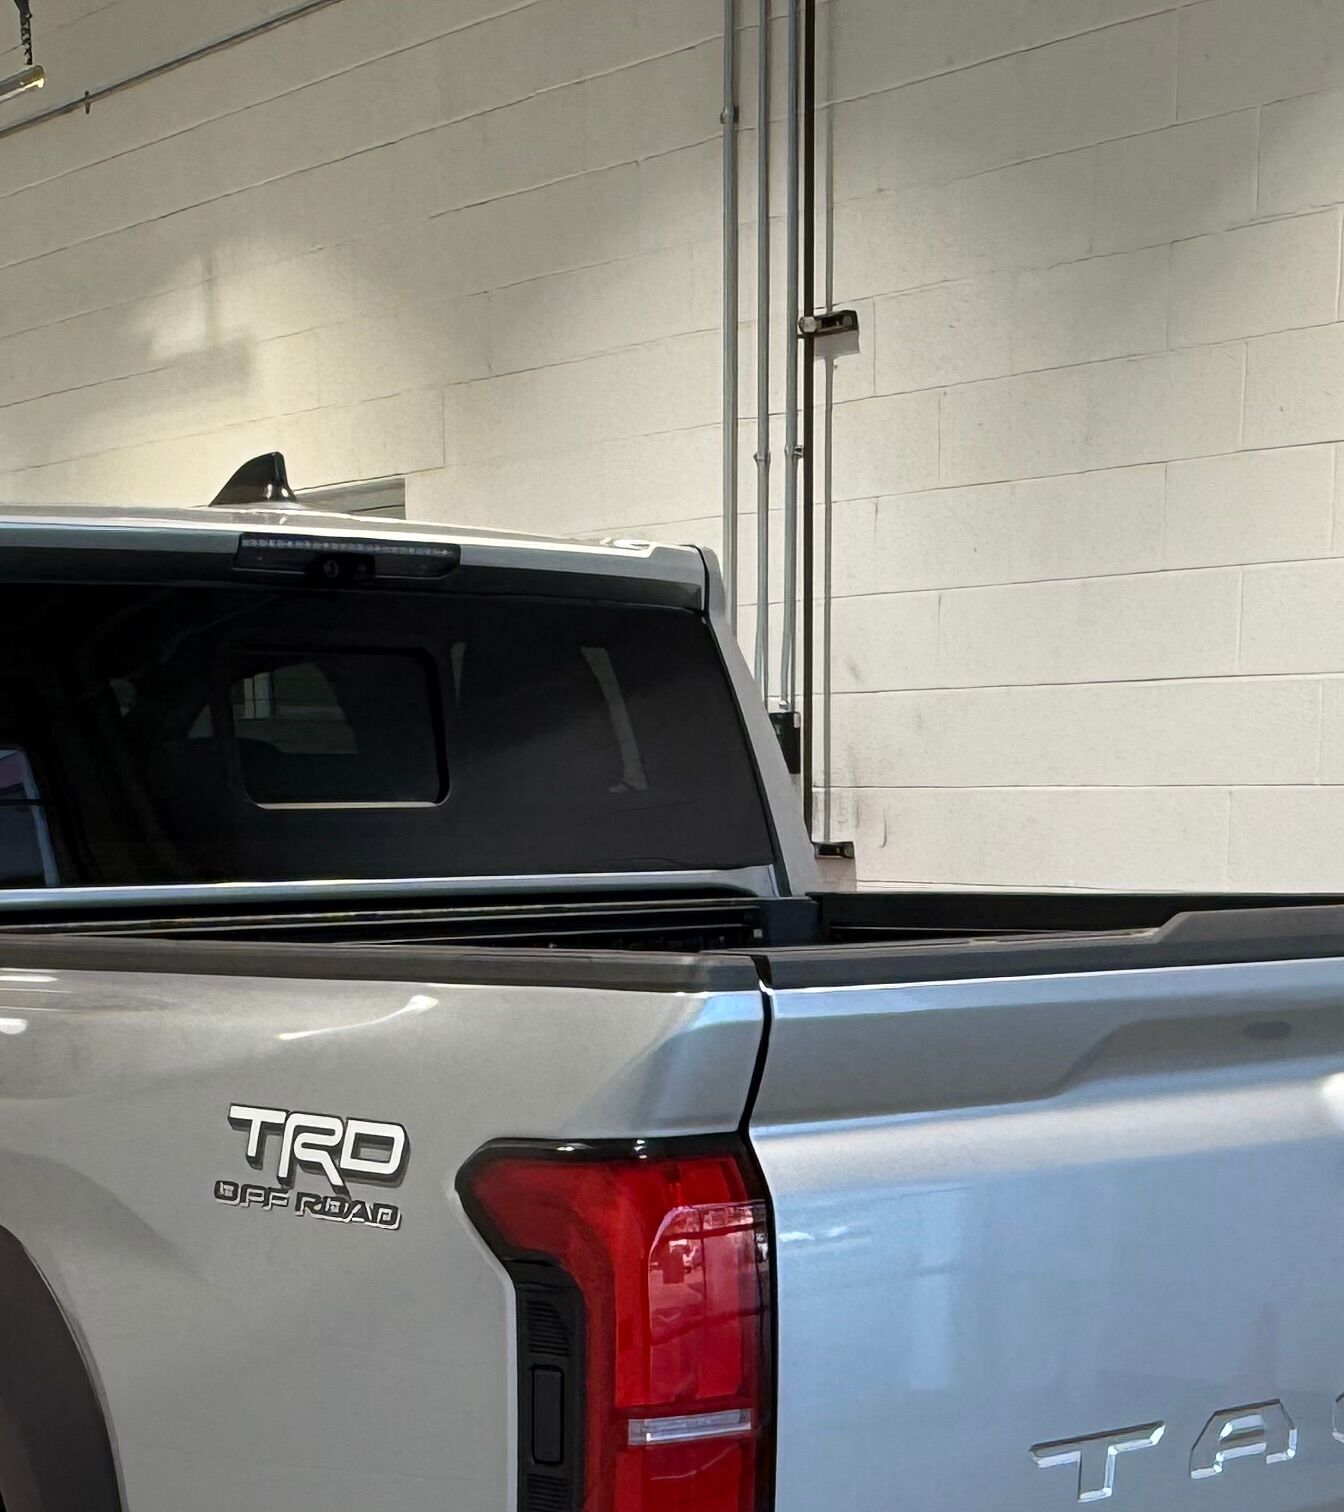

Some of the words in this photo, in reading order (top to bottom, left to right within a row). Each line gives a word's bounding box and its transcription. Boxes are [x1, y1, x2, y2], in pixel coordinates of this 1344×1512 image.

[227, 1103, 410, 1190] TRD
[214, 1179, 291, 1212] OFF
[294, 1191, 402, 1231] ROAD
